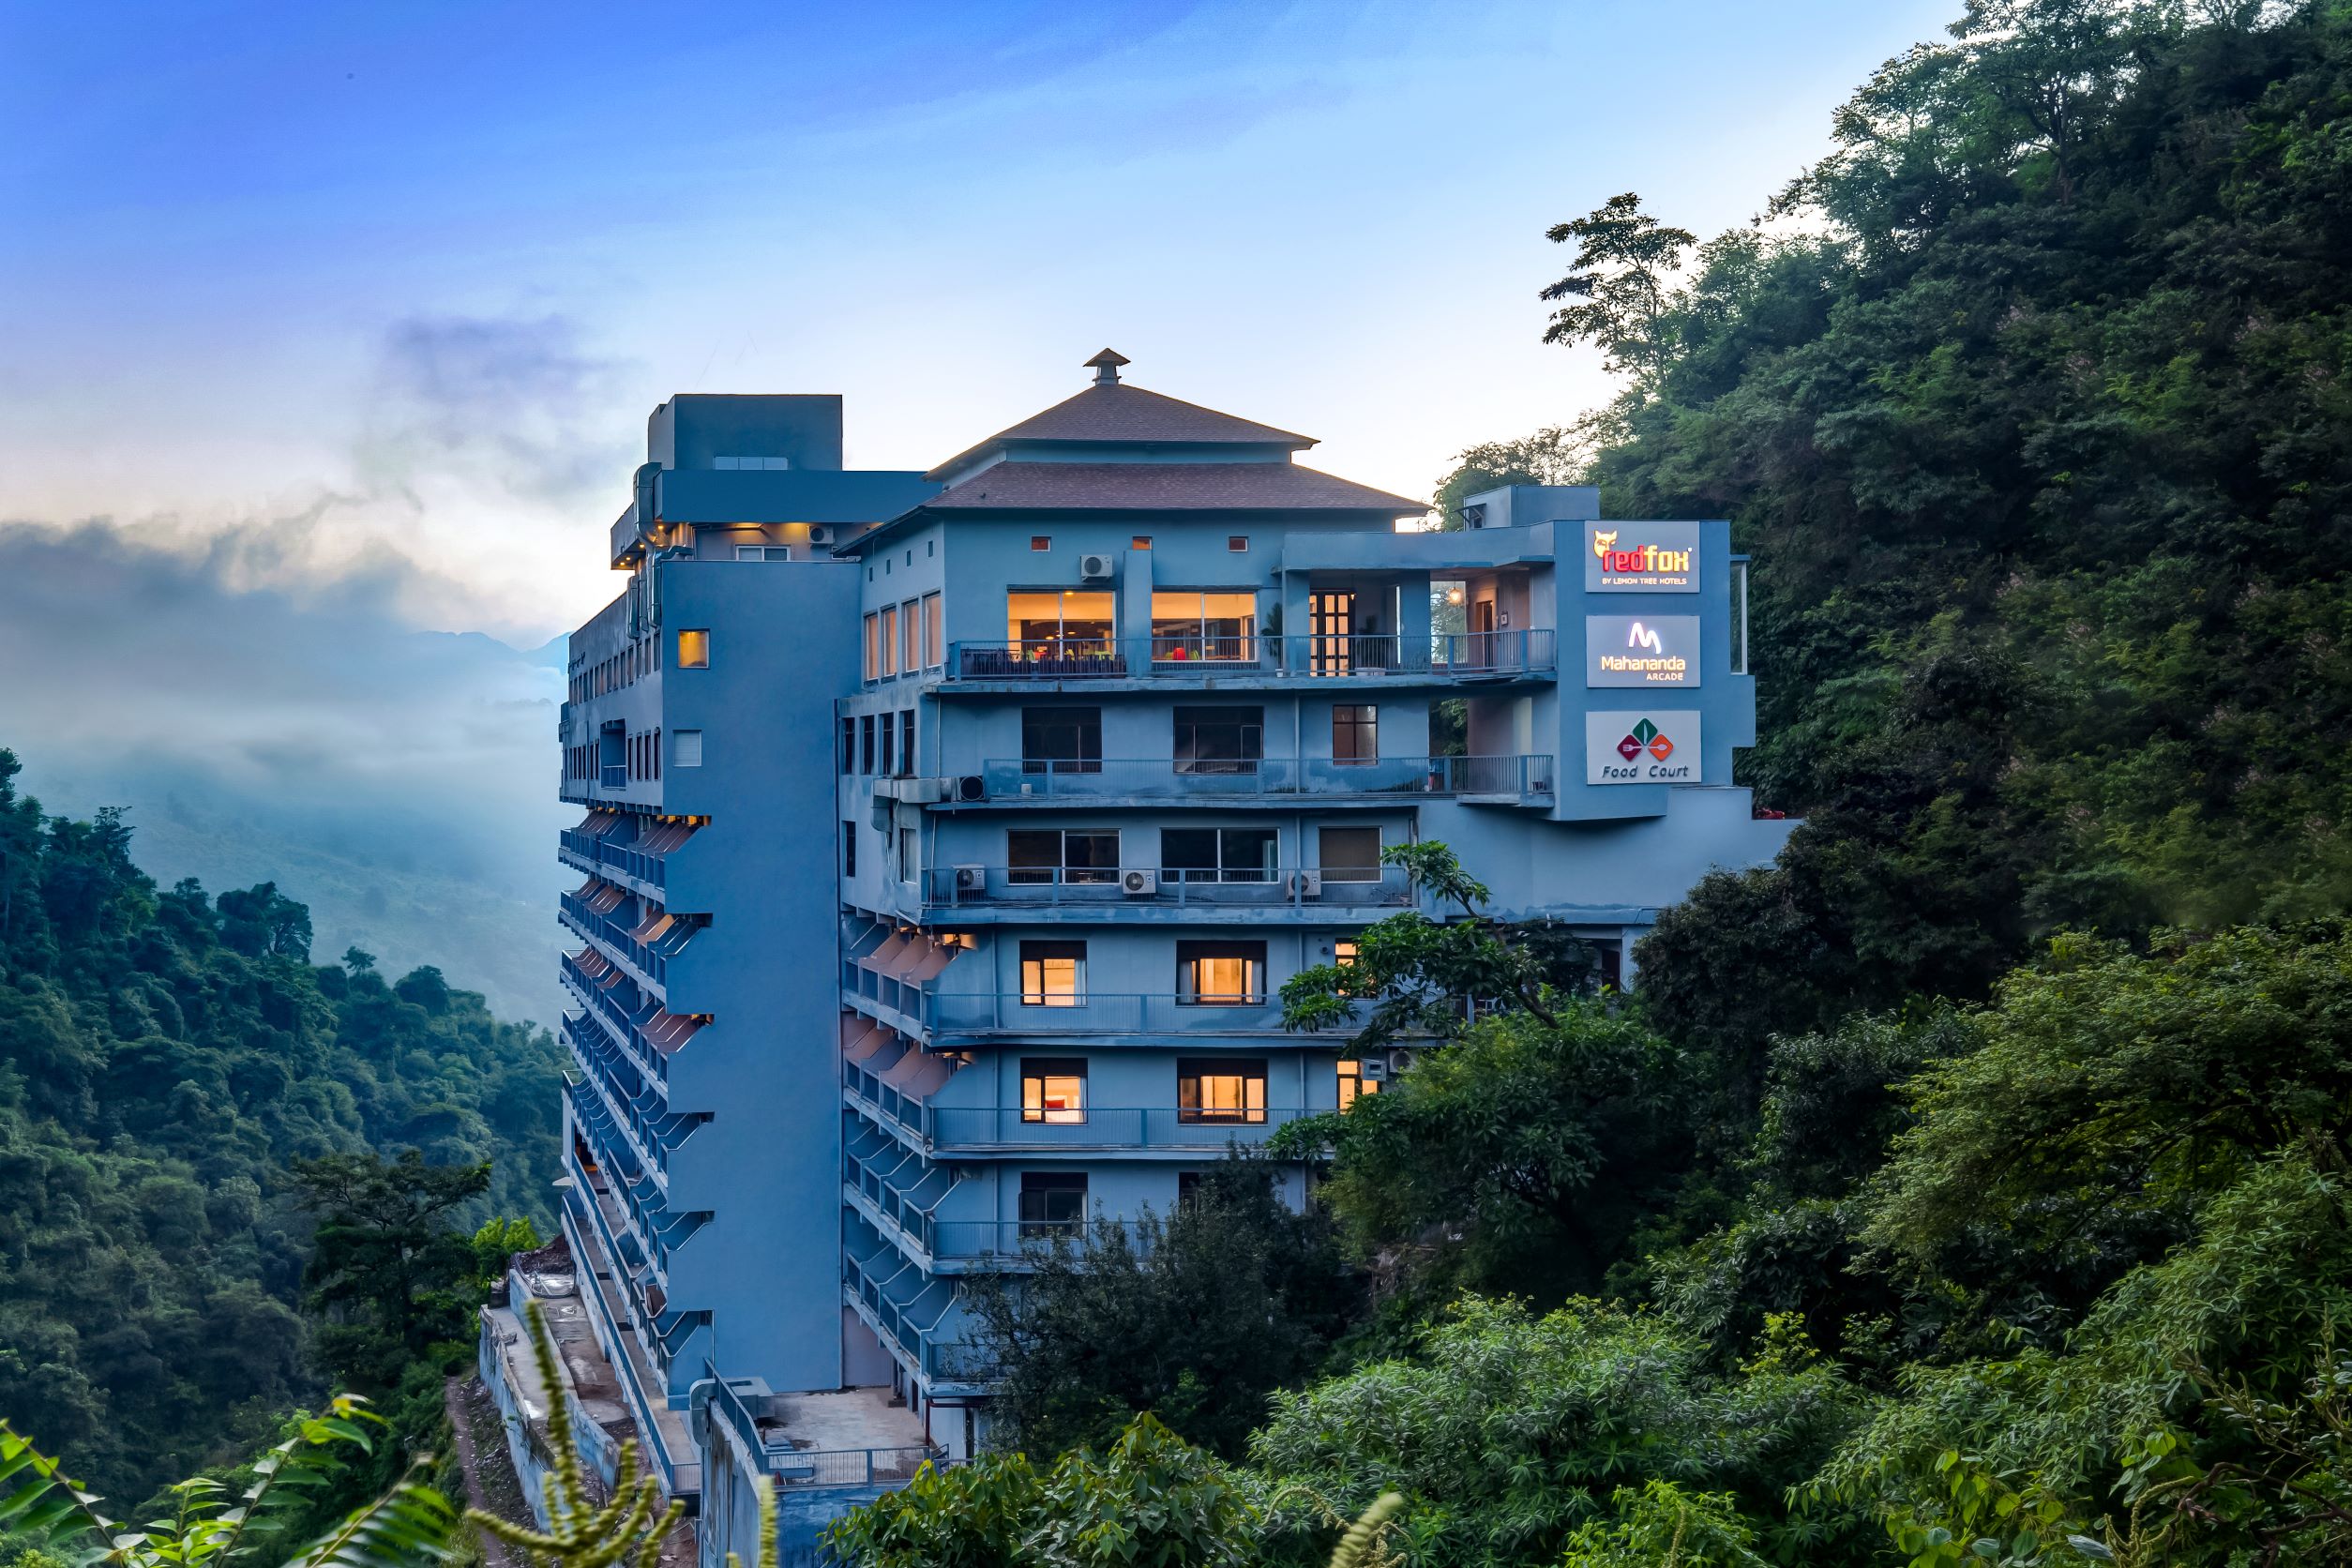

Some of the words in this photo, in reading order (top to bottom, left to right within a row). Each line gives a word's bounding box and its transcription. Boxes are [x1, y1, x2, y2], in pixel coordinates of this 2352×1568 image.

[1603, 545, 1689, 572] redfox
[1601, 656, 1686, 671] Mahananda
[1646, 672, 1683, 681] ARCADE
[1602, 765, 1638, 778] Food
[1649, 765, 1689, 777] Court
